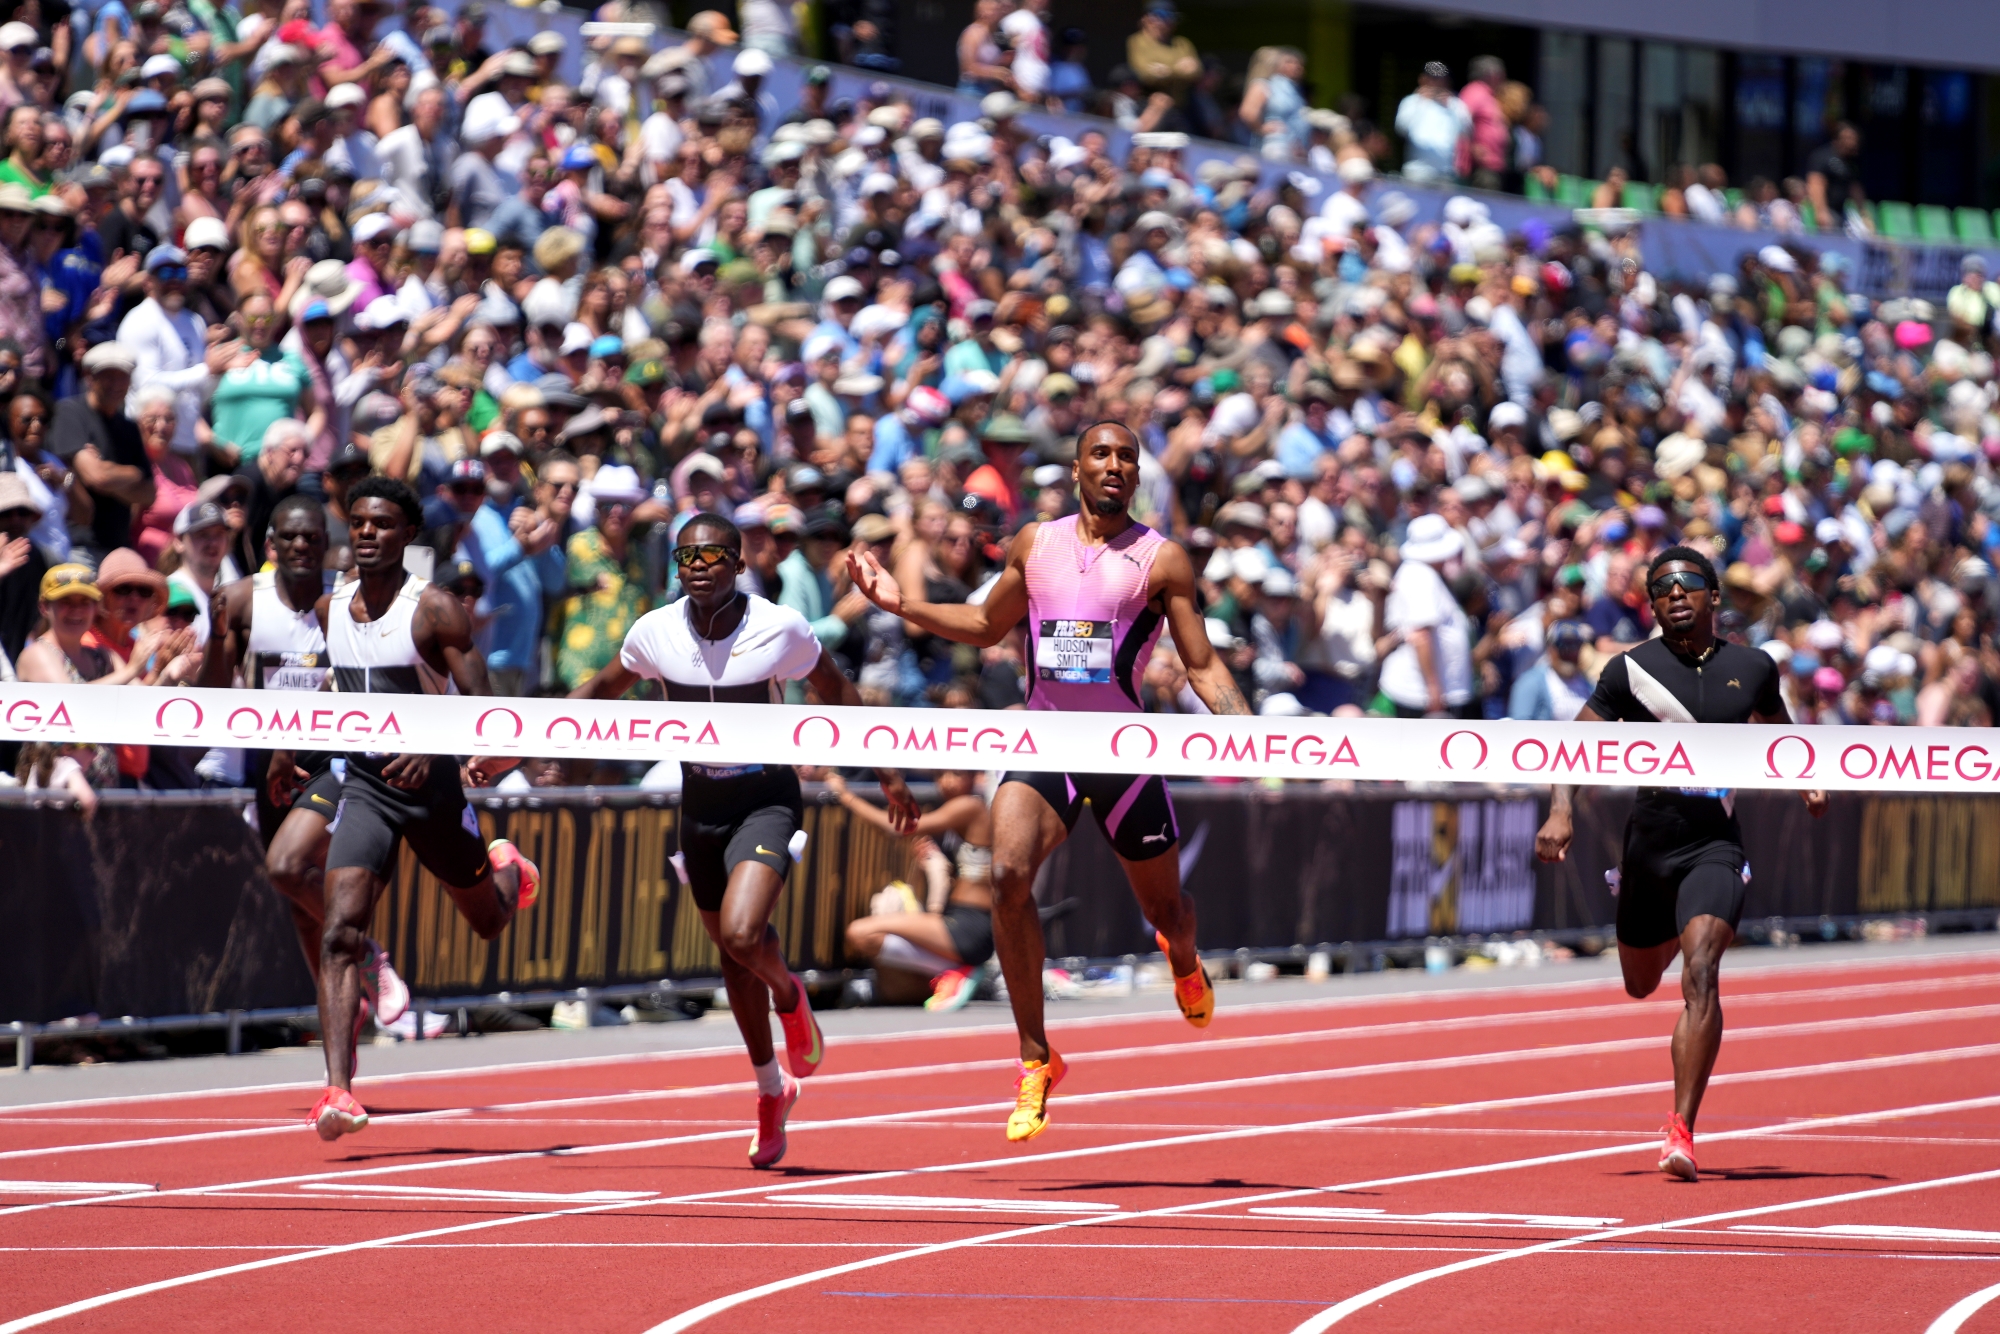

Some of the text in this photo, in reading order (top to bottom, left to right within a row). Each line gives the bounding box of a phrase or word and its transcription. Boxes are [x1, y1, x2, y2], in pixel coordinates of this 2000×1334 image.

[1053, 639, 1093, 653] HUDSON
[1056, 654, 1088, 667] SMITH
[278, 671, 318, 688] JAMES
[1054, 670, 1090, 679] EUGENE
[0, 699, 75, 734] GA
[227, 706, 406, 743] OMEGA
[545, 716, 721, 750] OMEGA
[863, 724, 1038, 755] OMEGA
[1181, 732, 1360, 768] OMEGA
[1511, 737, 1696, 776] OMEGA
[1839, 743, 2000, 781] OMEG
